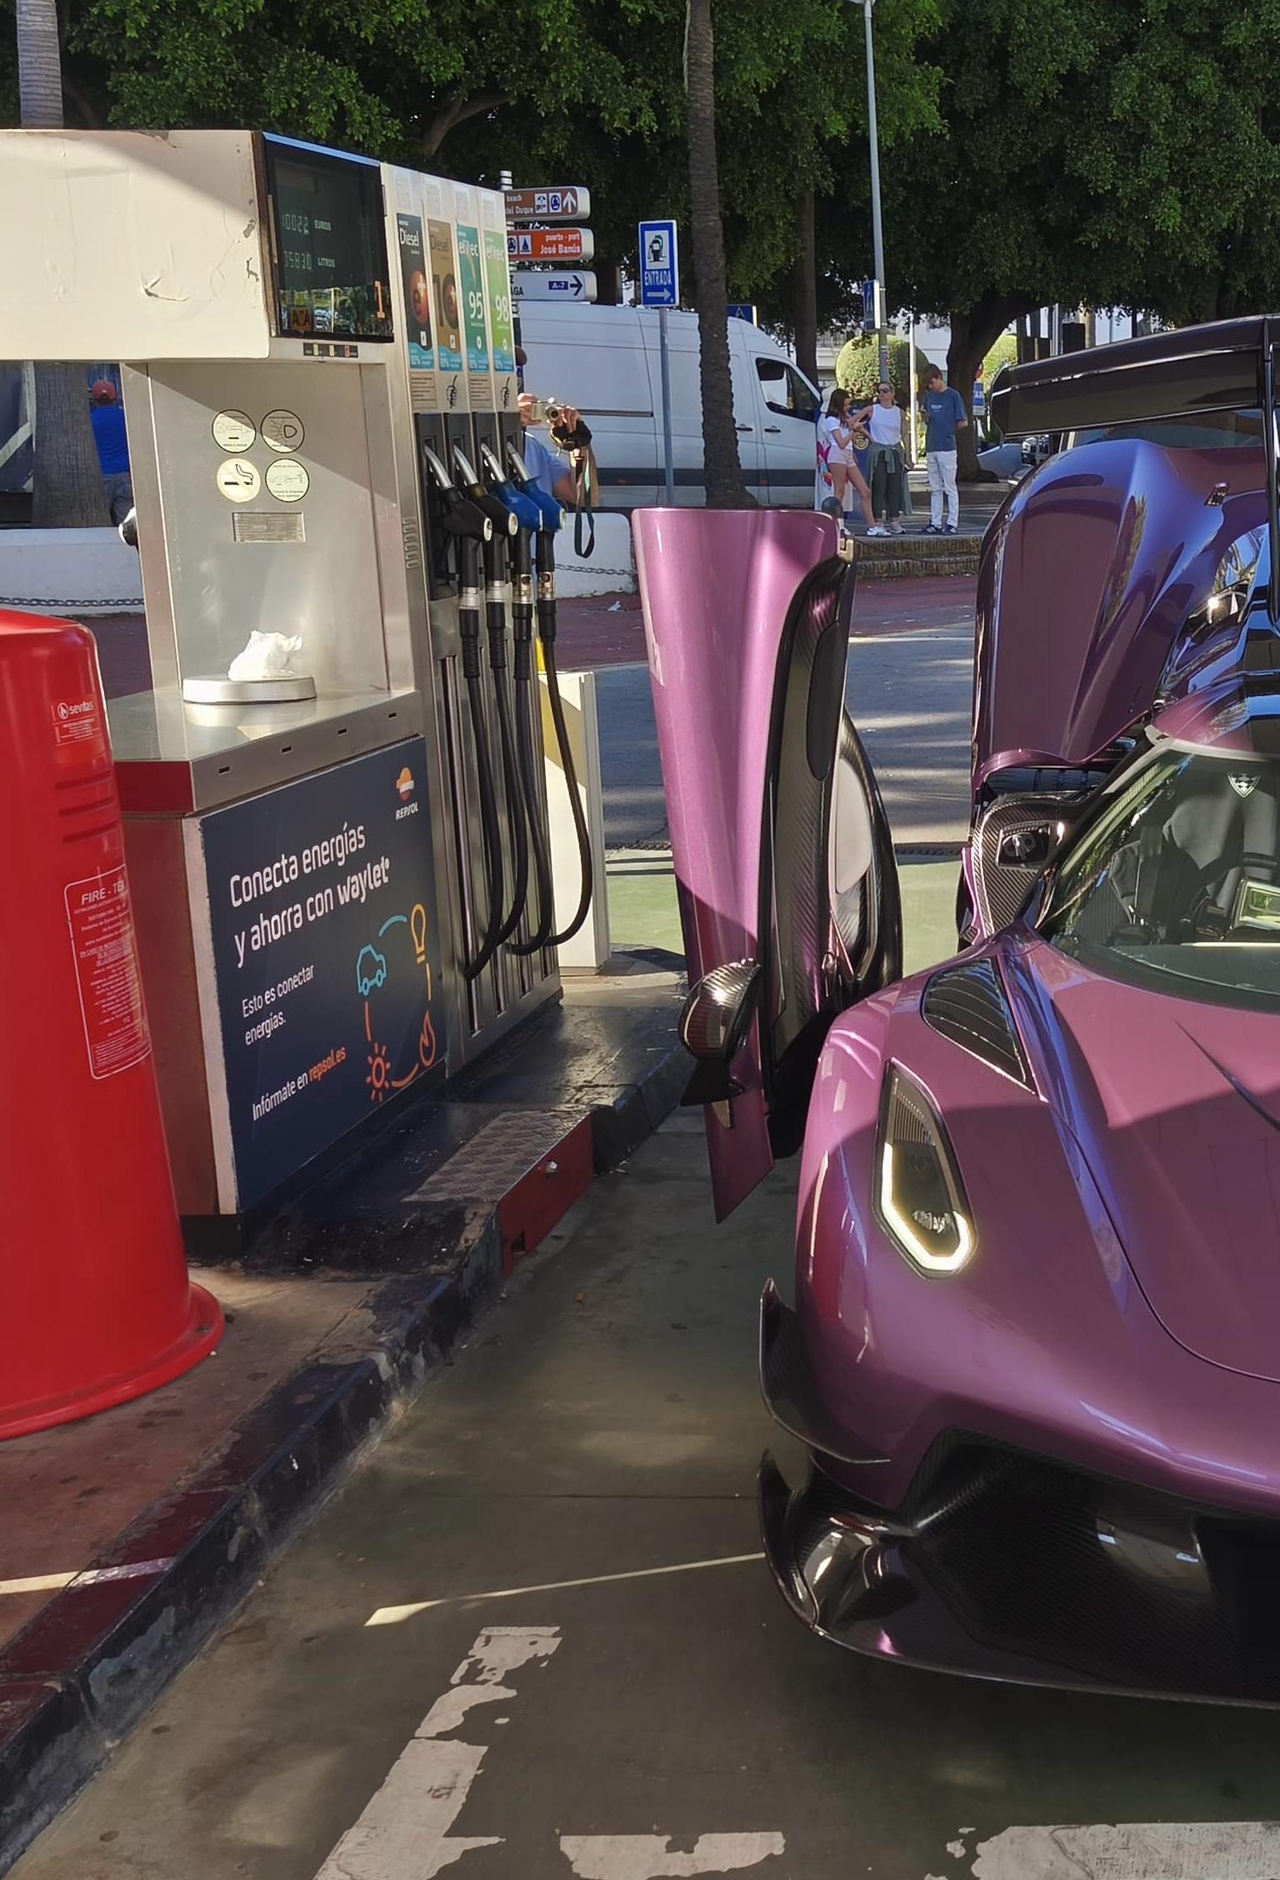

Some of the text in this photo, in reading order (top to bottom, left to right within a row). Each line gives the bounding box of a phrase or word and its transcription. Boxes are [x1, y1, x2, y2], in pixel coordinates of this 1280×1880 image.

[399, 227, 420, 247] Diesel
[644, 270, 672, 286] ENTRADA
[468, 291, 484, 320] 95
[495, 295, 511, 322] 98
[395, 801, 418, 821] REPSOL
[230, 821, 366, 908] Conecta energías
[81, 888, 106, 905] FIRE
[234, 930, 245, 969] y
[250, 903, 303, 951] ahorra
[306, 887, 334, 922] con
[242, 964, 315, 1018] Esto es conectar
[245, 1011, 287, 1046] energías.
[252, 1046, 347, 1121] Infórmate en repsol.es
